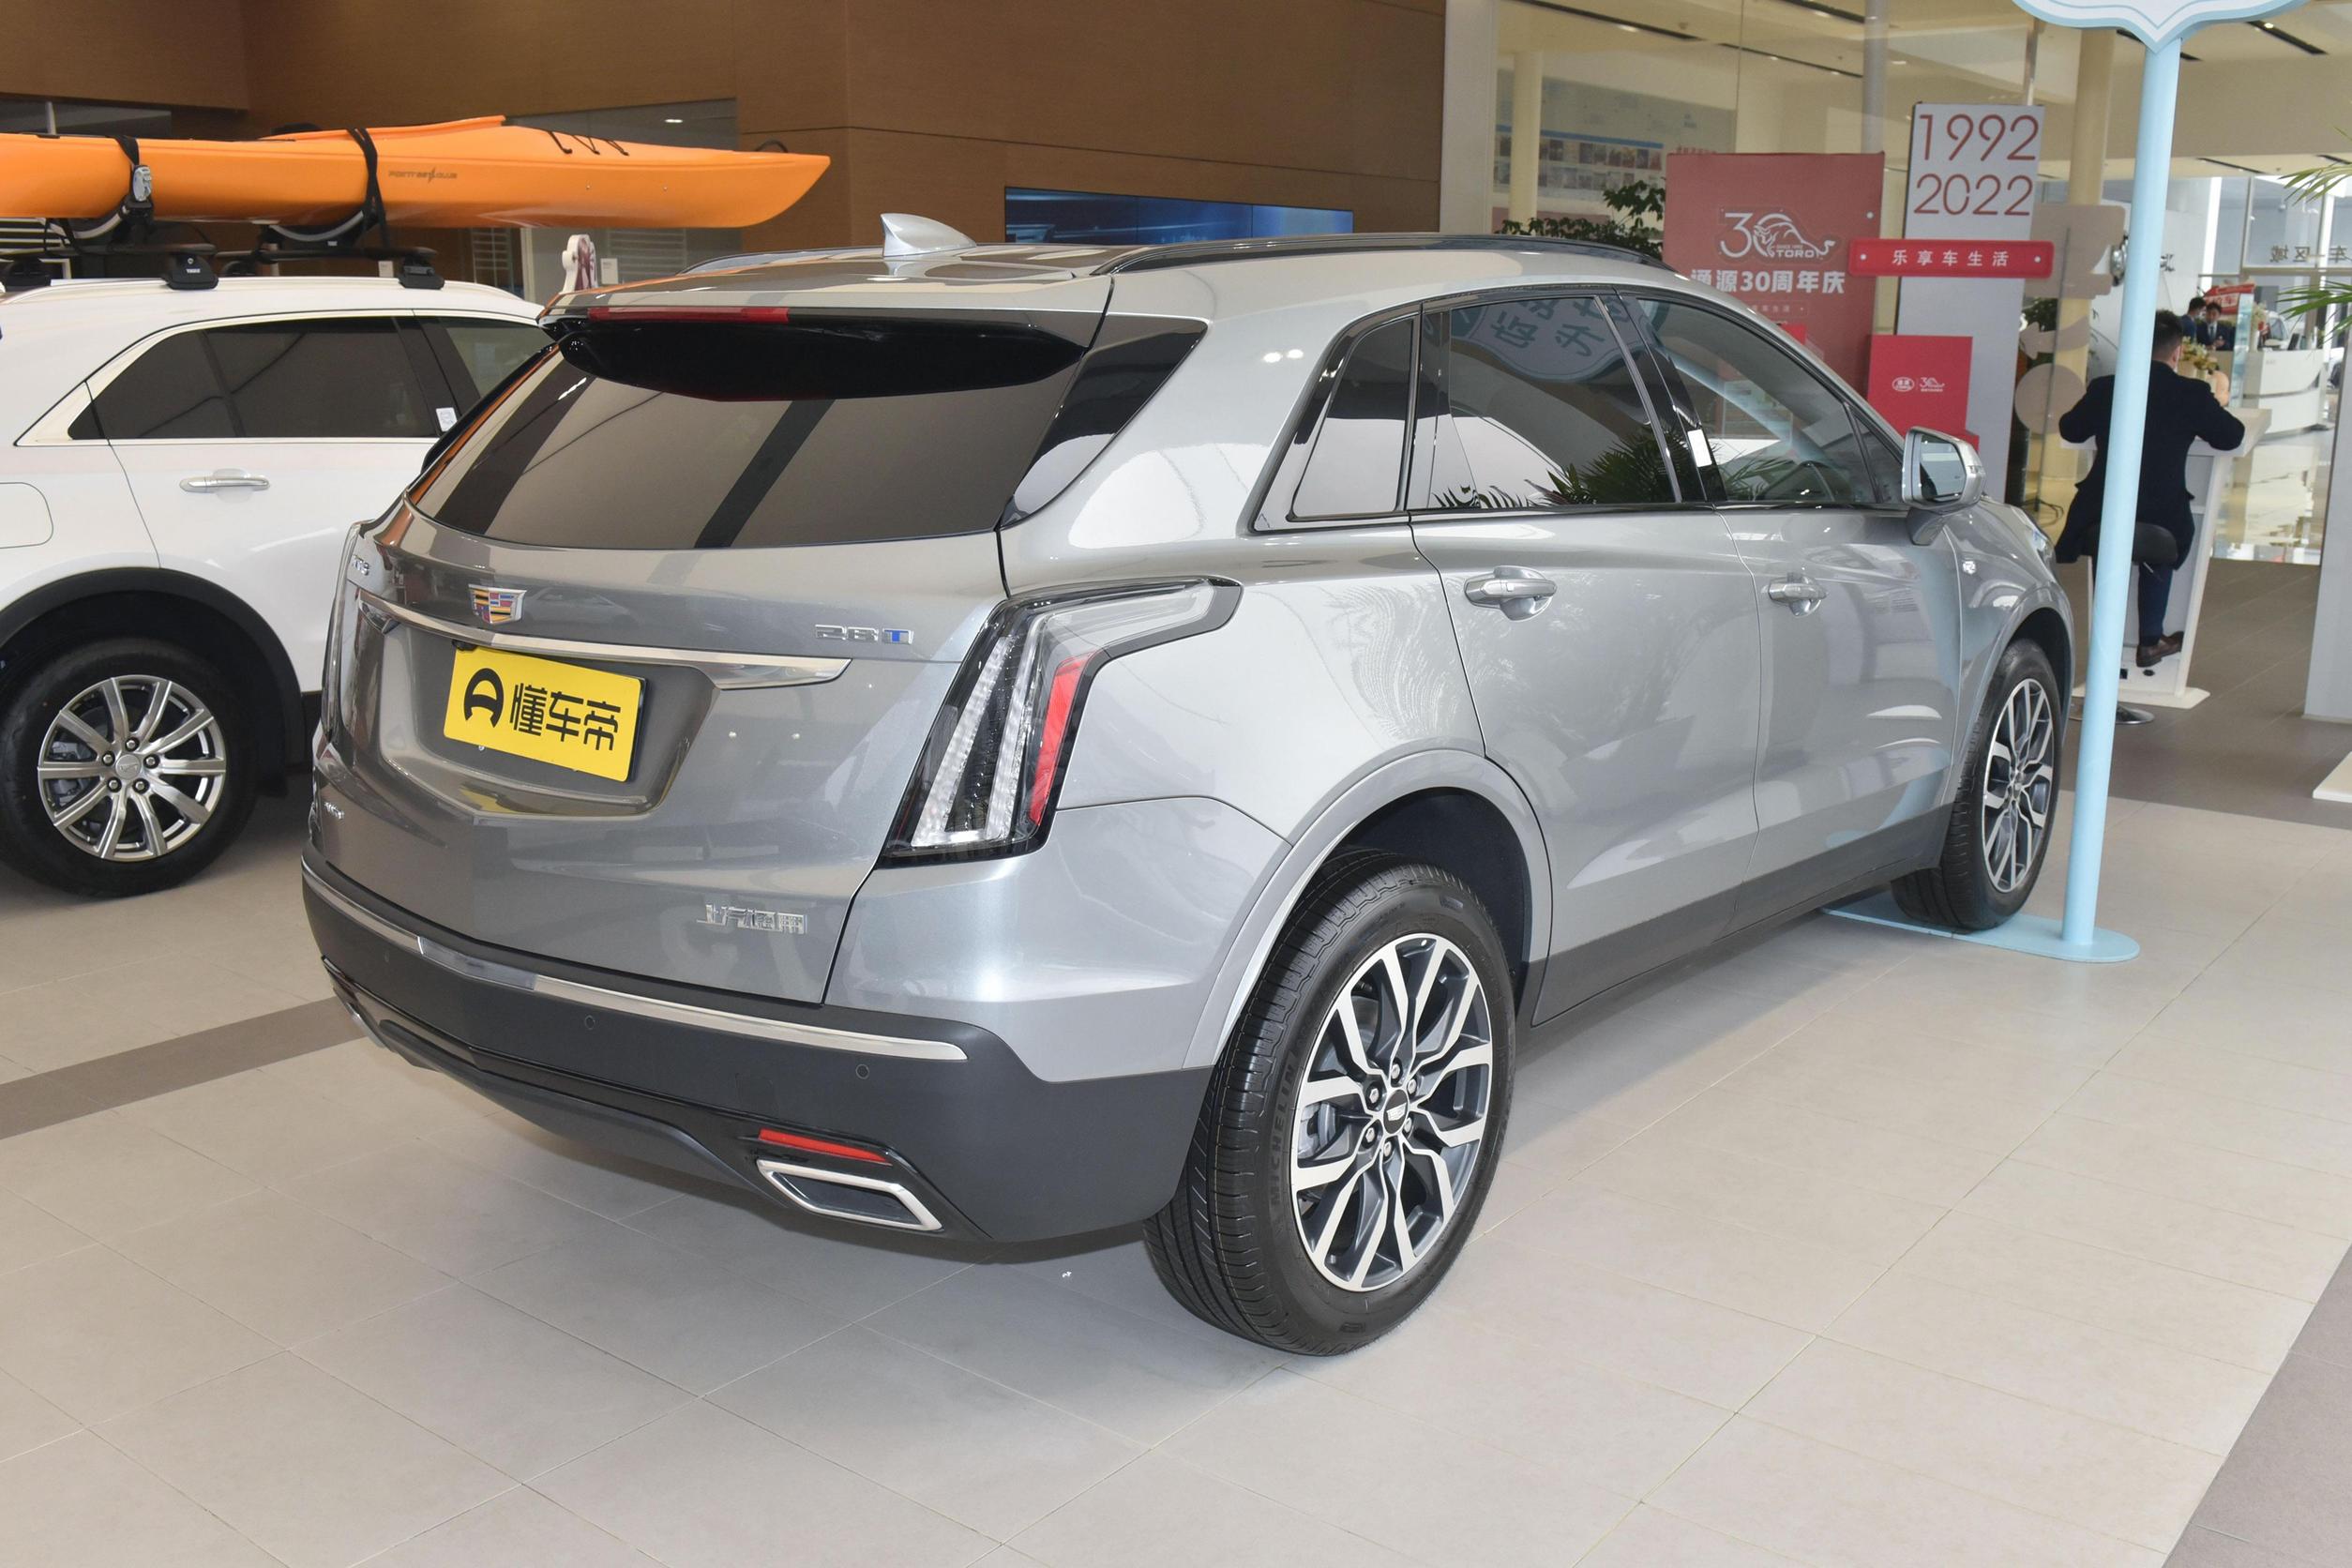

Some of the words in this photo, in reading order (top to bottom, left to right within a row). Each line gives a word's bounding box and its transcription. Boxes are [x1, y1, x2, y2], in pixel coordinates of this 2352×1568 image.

[1919, 113, 2039, 161] 1992
[1913, 173, 2033, 216] 2022
[1776, 249, 1815, 258] TORO
[1892, 249, 2010, 267] 乐享车生活
[814, 624, 913, 644] 28T
[509, 683, 622, 751] 懂车帝
